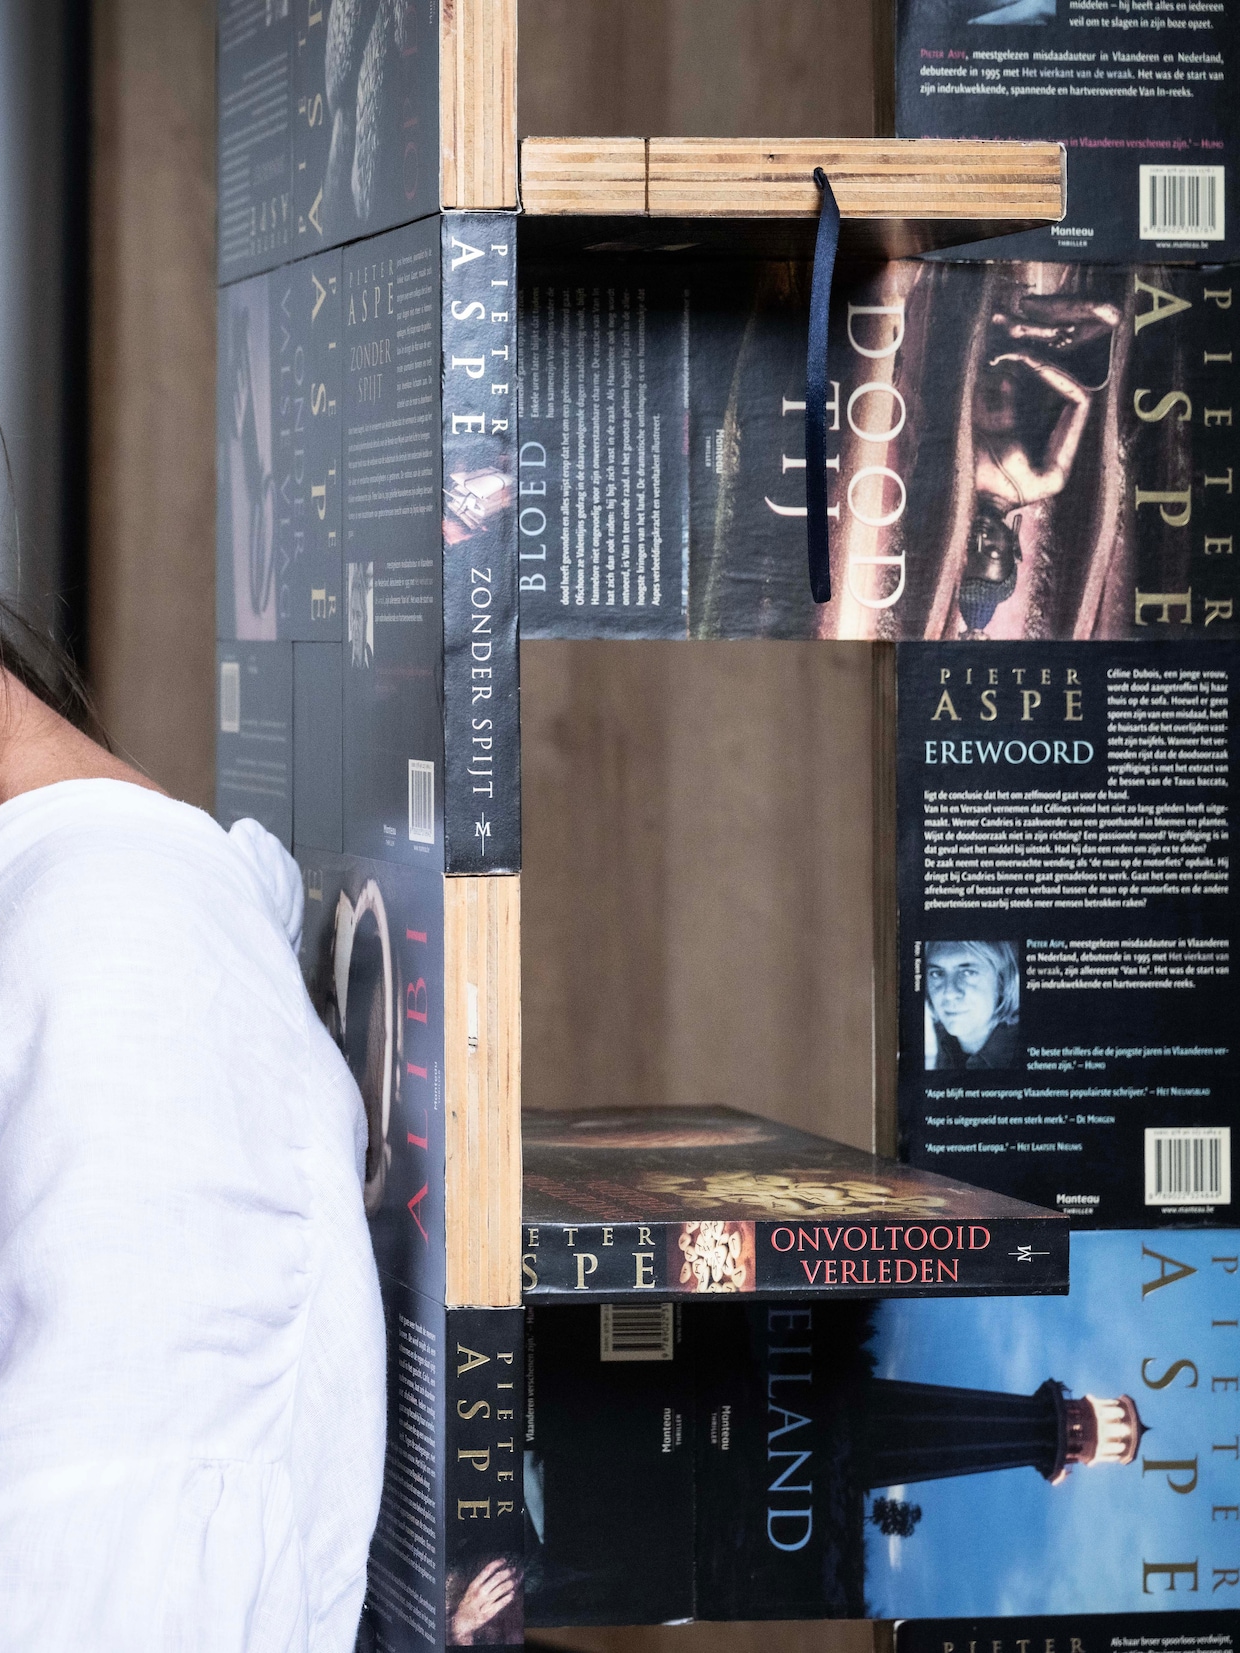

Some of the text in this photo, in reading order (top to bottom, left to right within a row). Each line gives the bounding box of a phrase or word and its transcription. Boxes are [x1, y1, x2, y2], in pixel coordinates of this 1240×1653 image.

[1068, 0, 1224, 13] middelen hij heeft alles en iedereen
[1068, 15, 1211, 30] veil om te slagen in zijn boze opzet.
[918, 64, 1224, 80] debuteerde in 1995 met Het vierkant van de wraak. Het was de start van
[971, 48, 1029, 63] meestgelezen
[1031, 48, 1096, 61] misdaadauteur
[1098, 50, 1109, 61] in
[1111, 50, 1160, 62] Vlaanderen
[1162, 53, 1174, 62] en
[1176, 51, 1223, 63] Nederland,
[918, 82, 936, 96] zijn
[935, 82, 1009, 95] indrukwekkende,
[1009, 84, 1056, 96] spannende
[1056, 86, 1068, 95] en
[1068, 84, 1137, 96] hartveroverende
[1138, 85, 1155, 96] Van
[1051, 226, 1094, 237] Manteau
[349, 259, 395, 288] PIETER
[348, 282, 395, 326] ASPE
[350, 338, 392, 372] ZONDER
[451, 236, 486, 435] ASPE
[491, 243, 508, 435] PIETER
[764, 380, 840, 521] TIJ
[847, 303, 907, 609] DOOD
[1133, 274, 1193, 626] ASPE
[1204, 287, 1233, 628] PIETER
[518, 441, 547, 592] BLOED
[650, 414, 662, 606] Aspes verbeeldingskracht en verteltalent illustreert.
[467, 567, 494, 799] ZONDER SPIJT
[940, 668, 1082, 685] PIETER
[930, 690, 1084, 721] ASPE
[924, 740, 1095, 765] EREWOORD
[1068, 938, 1120, 950] meestgelezen
[1120, 937, 1176, 948] misdaadauteur
[1177, 939, 1186, 947] in
[1186, 937, 1229, 947] Vlaanderen
[1025, 977, 1194, 991] zijn indrukwekkende en hartveroverende reeks.
[406, 927, 429, 1250] ALIBI
[1056, 1194, 1100, 1205] Manteau
[770, 1225, 992, 1253] ONVOLTOOID
[800, 1258, 959, 1285] VERLEDEN
[457, 1342, 491, 1520] ASPE
[496, 1351, 514, 1516] PIETER
[662, 1407, 672, 1453] Manteau
[722, 1405, 731, 1451] Manteau
[767, 1307, 813, 1552] EILAND
[1141, 1241, 1199, 1595] ASPE
[1211, 1255, 1240, 1593] PIETER
